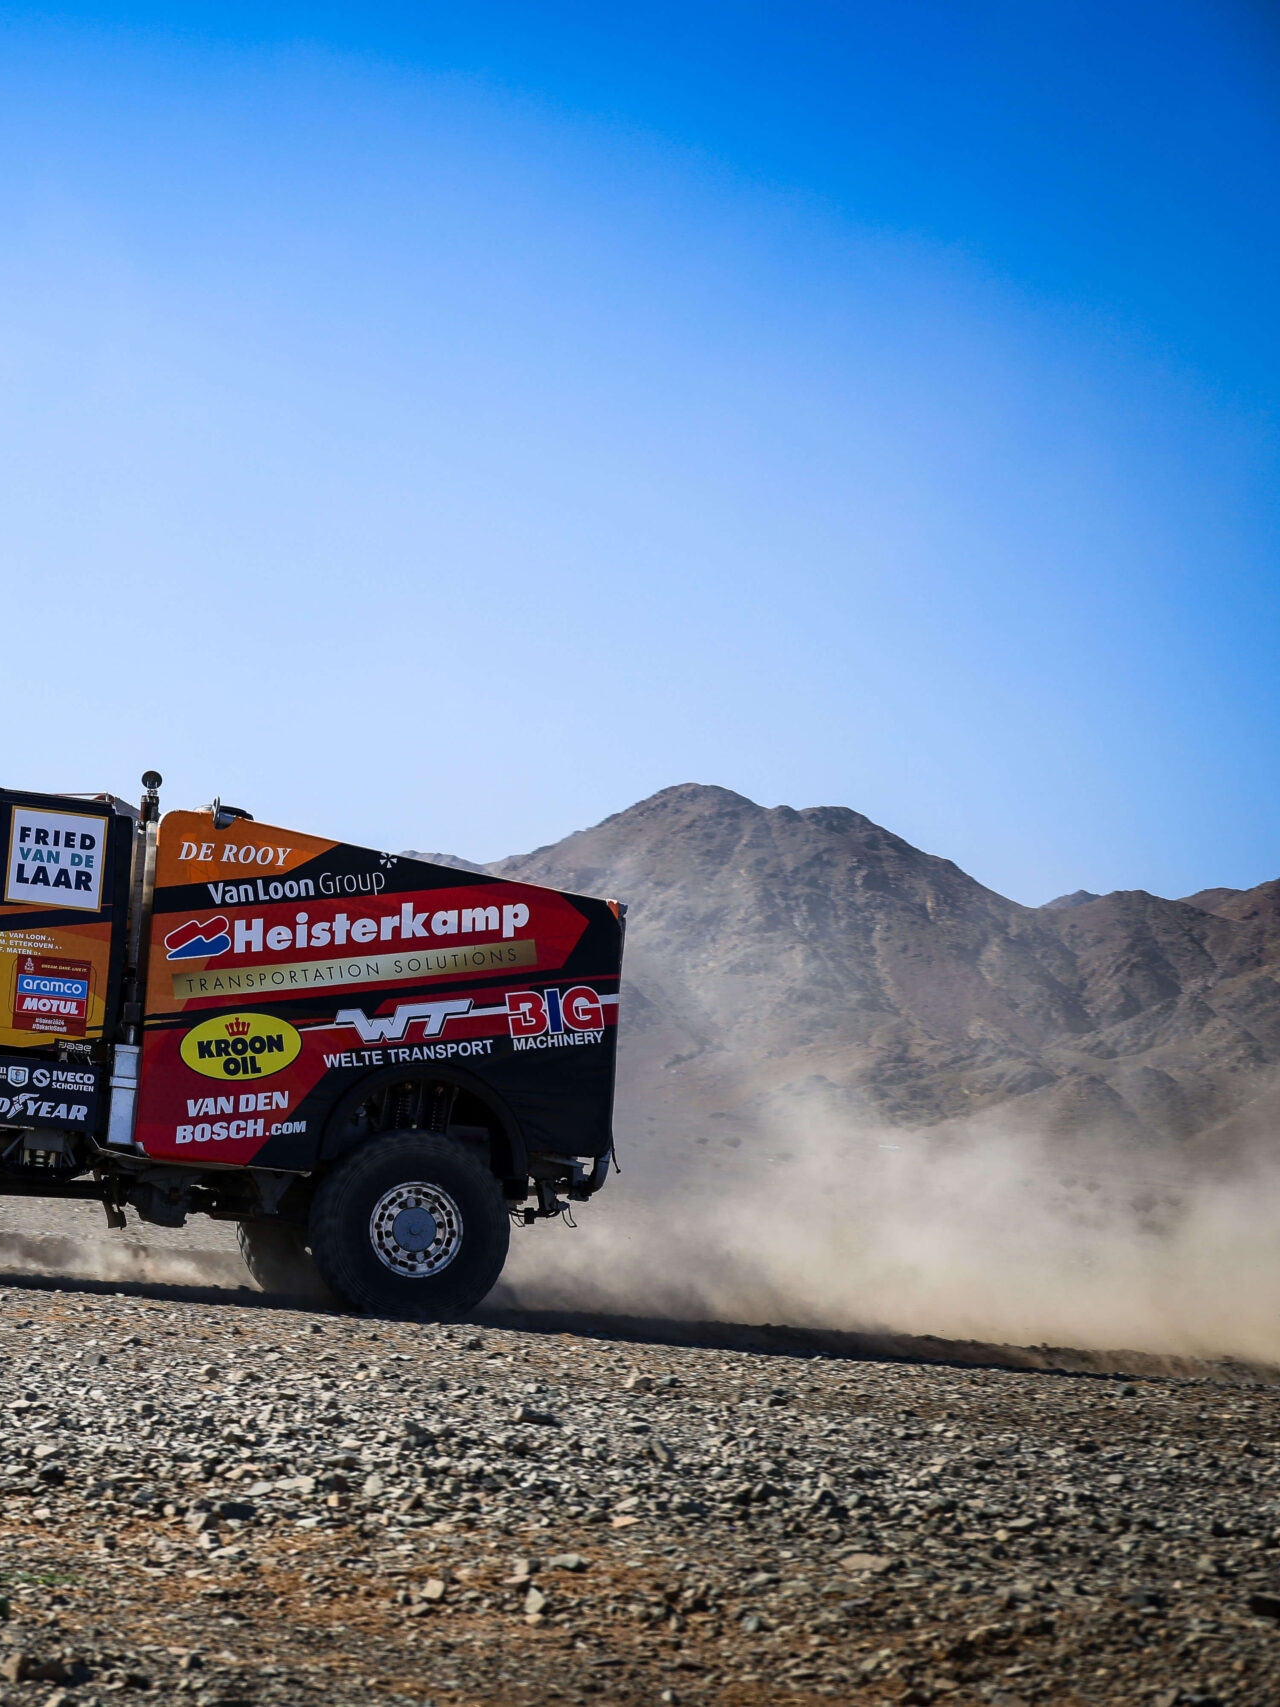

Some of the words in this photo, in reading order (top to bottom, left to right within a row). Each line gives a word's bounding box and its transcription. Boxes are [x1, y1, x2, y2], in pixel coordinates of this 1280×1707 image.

[19, 826, 96, 850] FRIED
[19, 847, 60, 864] VAN
[70, 853, 94, 868] DE
[177, 841, 215, 861] DE
[220, 843, 292, 866] ROOY
[16, 863, 92, 891] LAAR
[319, 872, 385, 895] Group
[25, 933, 46, 941] LOON
[234, 901, 530, 953] Heisterkamp
[6, 947, 32, 955] MATEN
[185, 962, 380, 992] TRANSPORTATION
[393, 948, 517, 974] SOLUTIONS
[22, 979, 82, 994] aramco
[22, 997, 79, 1015] MOTUL
[505, 985, 605, 1038] BIG
[334, 998, 474, 1044] WT
[197, 1034, 285, 1059] KROON
[513, 1031, 604, 1051] MACHINERY
[323, 1050, 384, 1068] WELTE
[388, 1039, 494, 1064] TRANSPORT
[52, 1070, 95, 1084] IVECO
[222, 1057, 262, 1076] OIL
[51, 1082, 95, 1092] SCHOUTEN
[186, 1095, 234, 1117] VAN
[238, 1090, 289, 1113] DEN
